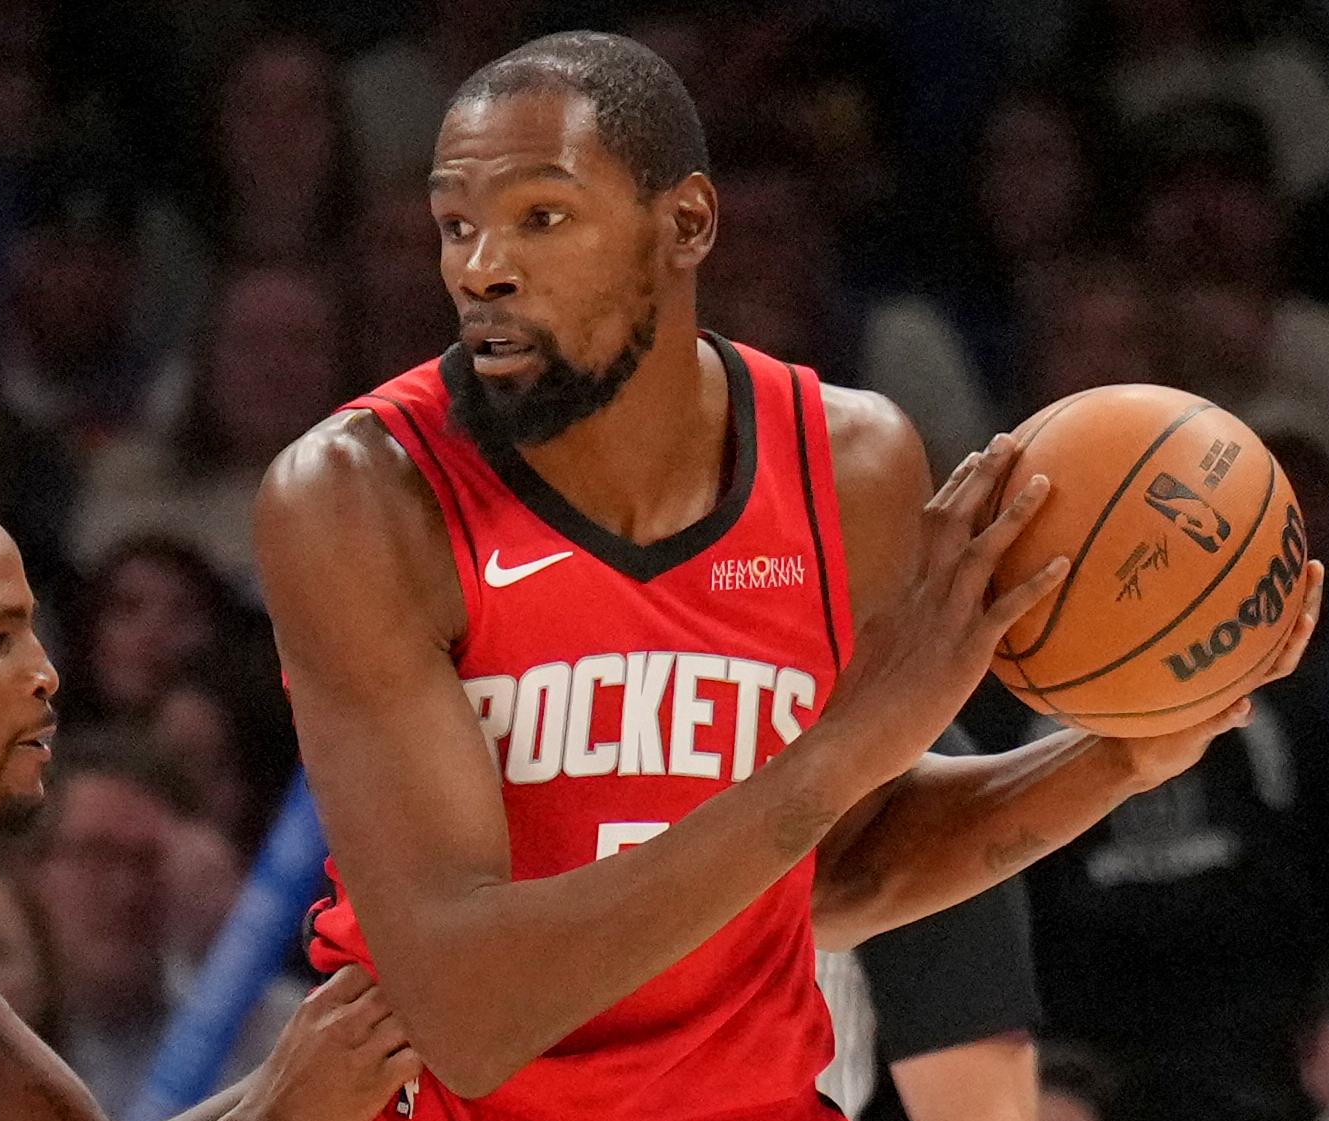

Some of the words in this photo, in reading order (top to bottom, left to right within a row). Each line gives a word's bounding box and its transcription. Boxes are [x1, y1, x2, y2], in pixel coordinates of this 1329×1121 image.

[712, 555, 805, 577] MEMORIAL
[711, 571, 805, 591] HERMANN
[1160, 503, 1308, 684] Wilson
